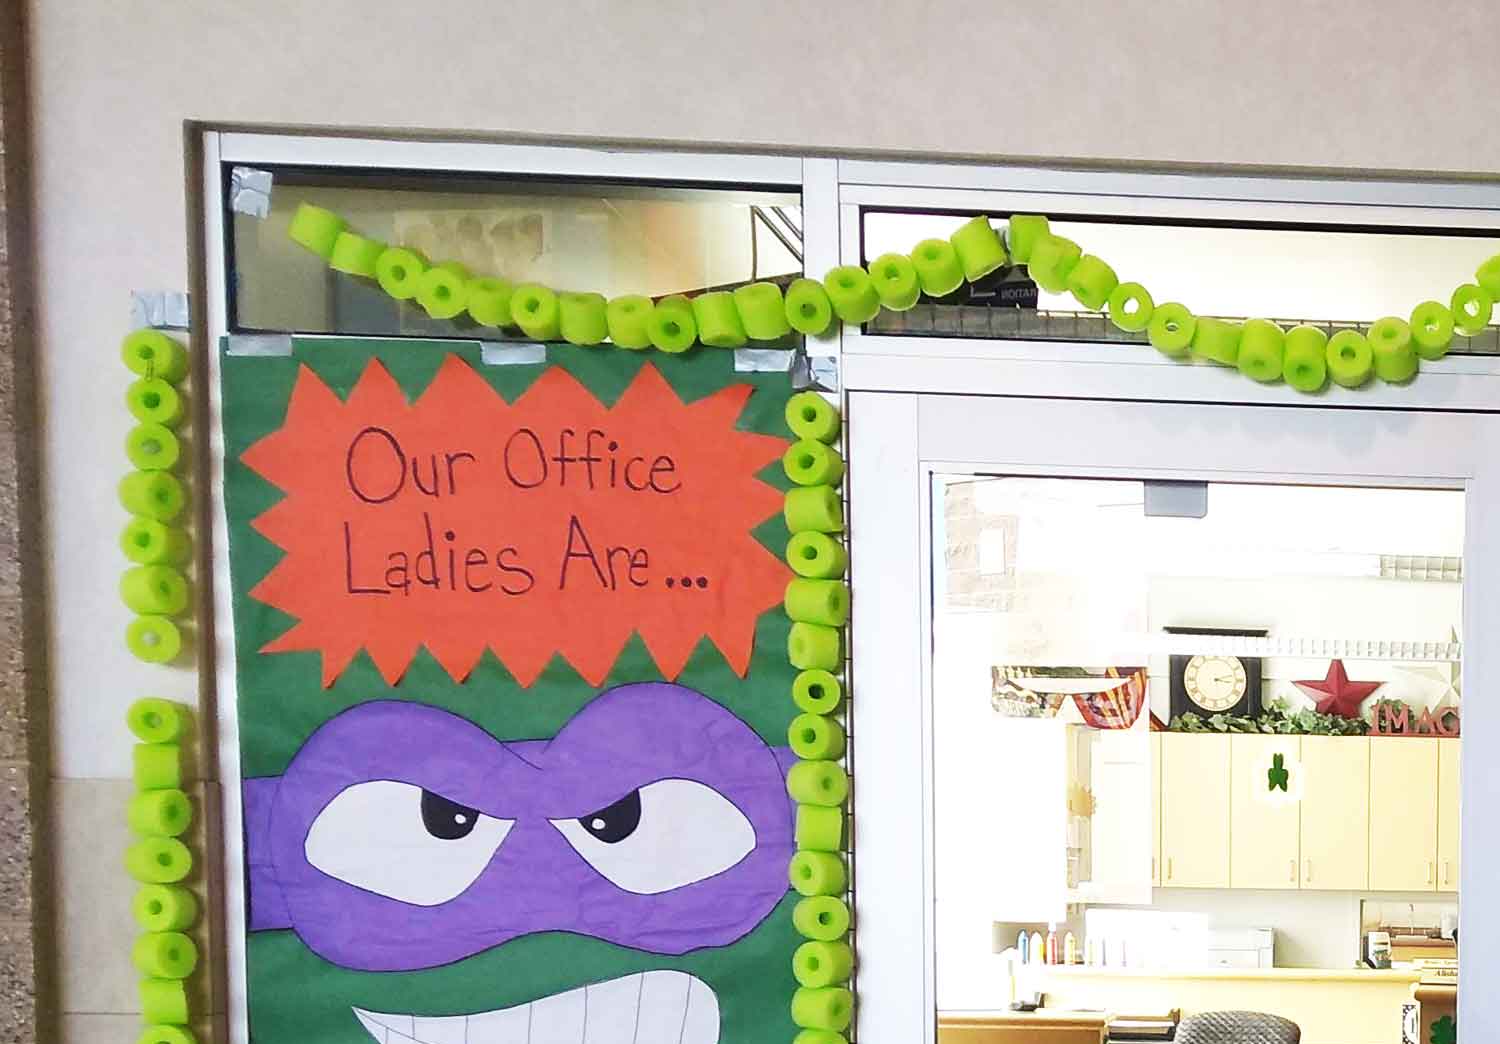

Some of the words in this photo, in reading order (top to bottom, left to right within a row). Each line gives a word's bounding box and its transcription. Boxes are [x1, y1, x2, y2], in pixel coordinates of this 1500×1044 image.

[346, 426, 476, 504] Our
[504, 428, 682, 494] Office
[343, 512, 535, 596] Ladies
